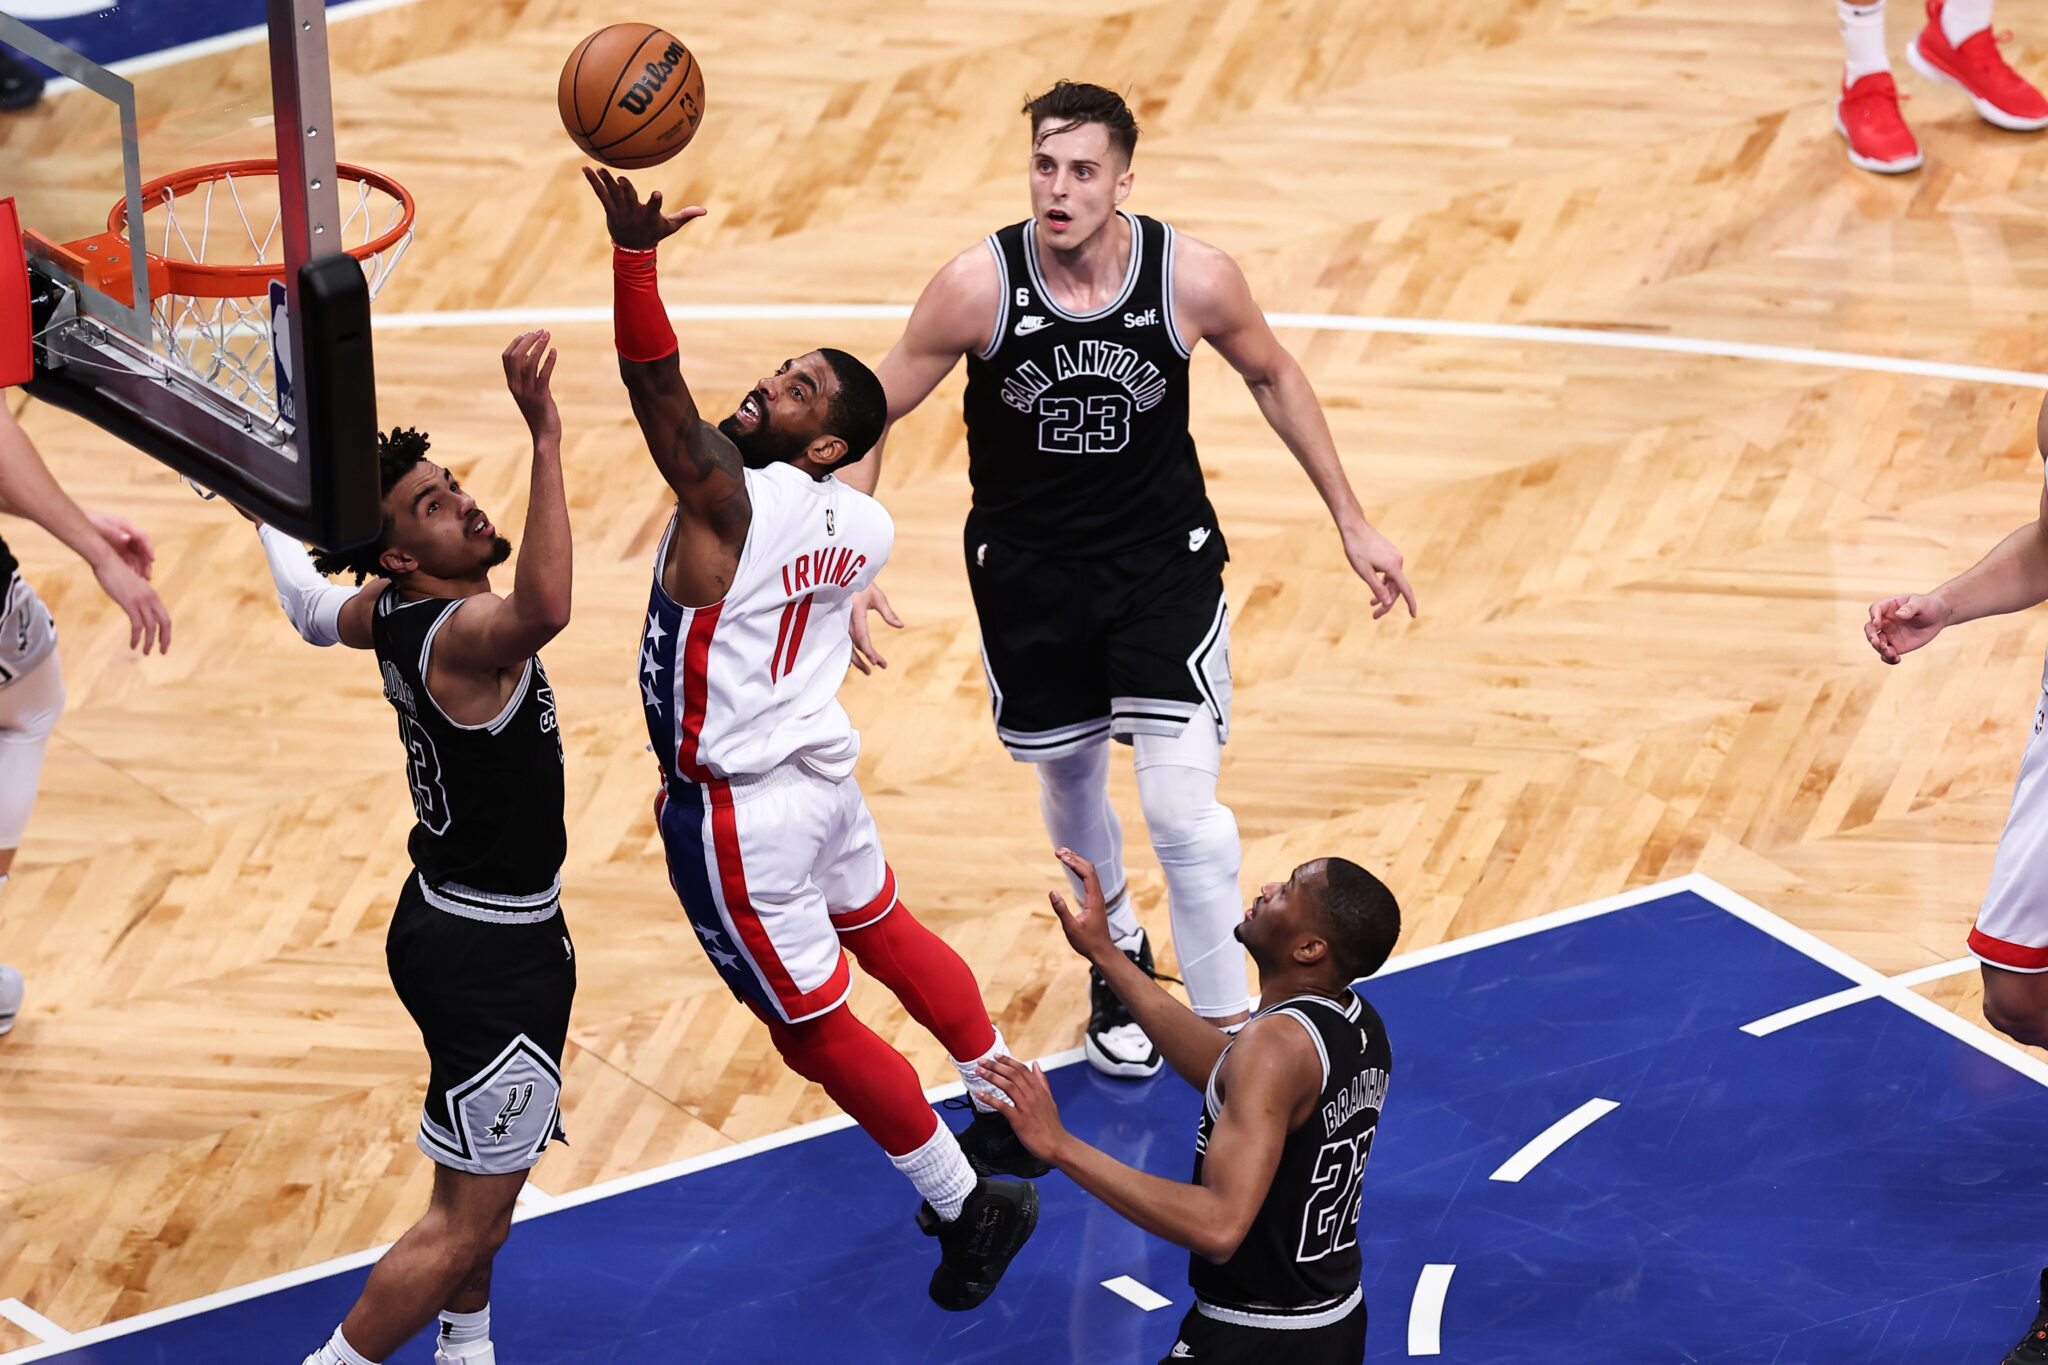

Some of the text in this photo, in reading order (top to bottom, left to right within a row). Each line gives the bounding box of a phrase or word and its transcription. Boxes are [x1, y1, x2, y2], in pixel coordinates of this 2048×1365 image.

[617, 41, 685, 116] Wilson
[1015, 287, 1030, 307] 6
[1020, 315, 1046, 329] NIKE
[1001, 340, 1167, 414] SAN ANTONIO
[1038, 394, 1131, 454] 23
[782, 546, 867, 597] IRVING
[770, 592, 814, 686] 11
[1295, 1125, 1376, 1262] 22
